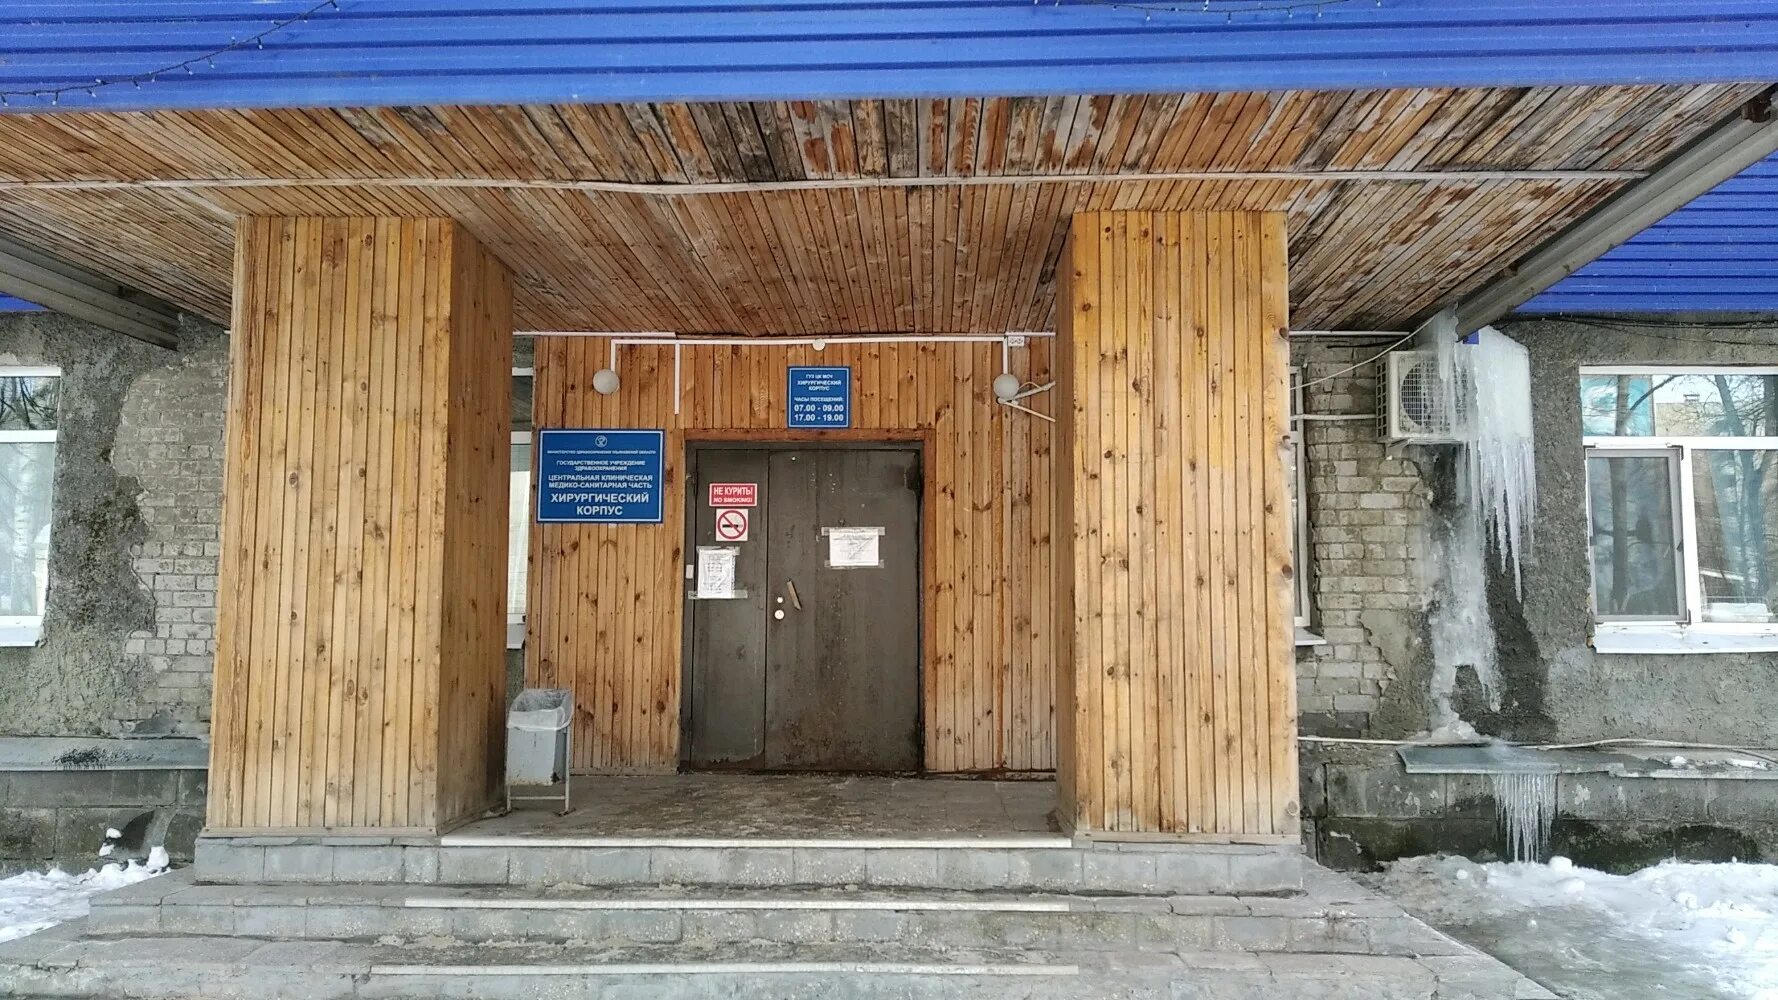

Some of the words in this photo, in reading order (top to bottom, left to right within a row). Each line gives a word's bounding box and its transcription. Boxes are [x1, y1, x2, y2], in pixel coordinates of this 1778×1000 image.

[713, 486, 724, 495] НЕ
[724, 486, 753, 495] КУРИТЬ!
[550, 492, 649, 503] ХИРУРГИЧЕСКИЙ
[576, 506, 623, 516] КОРПУС
